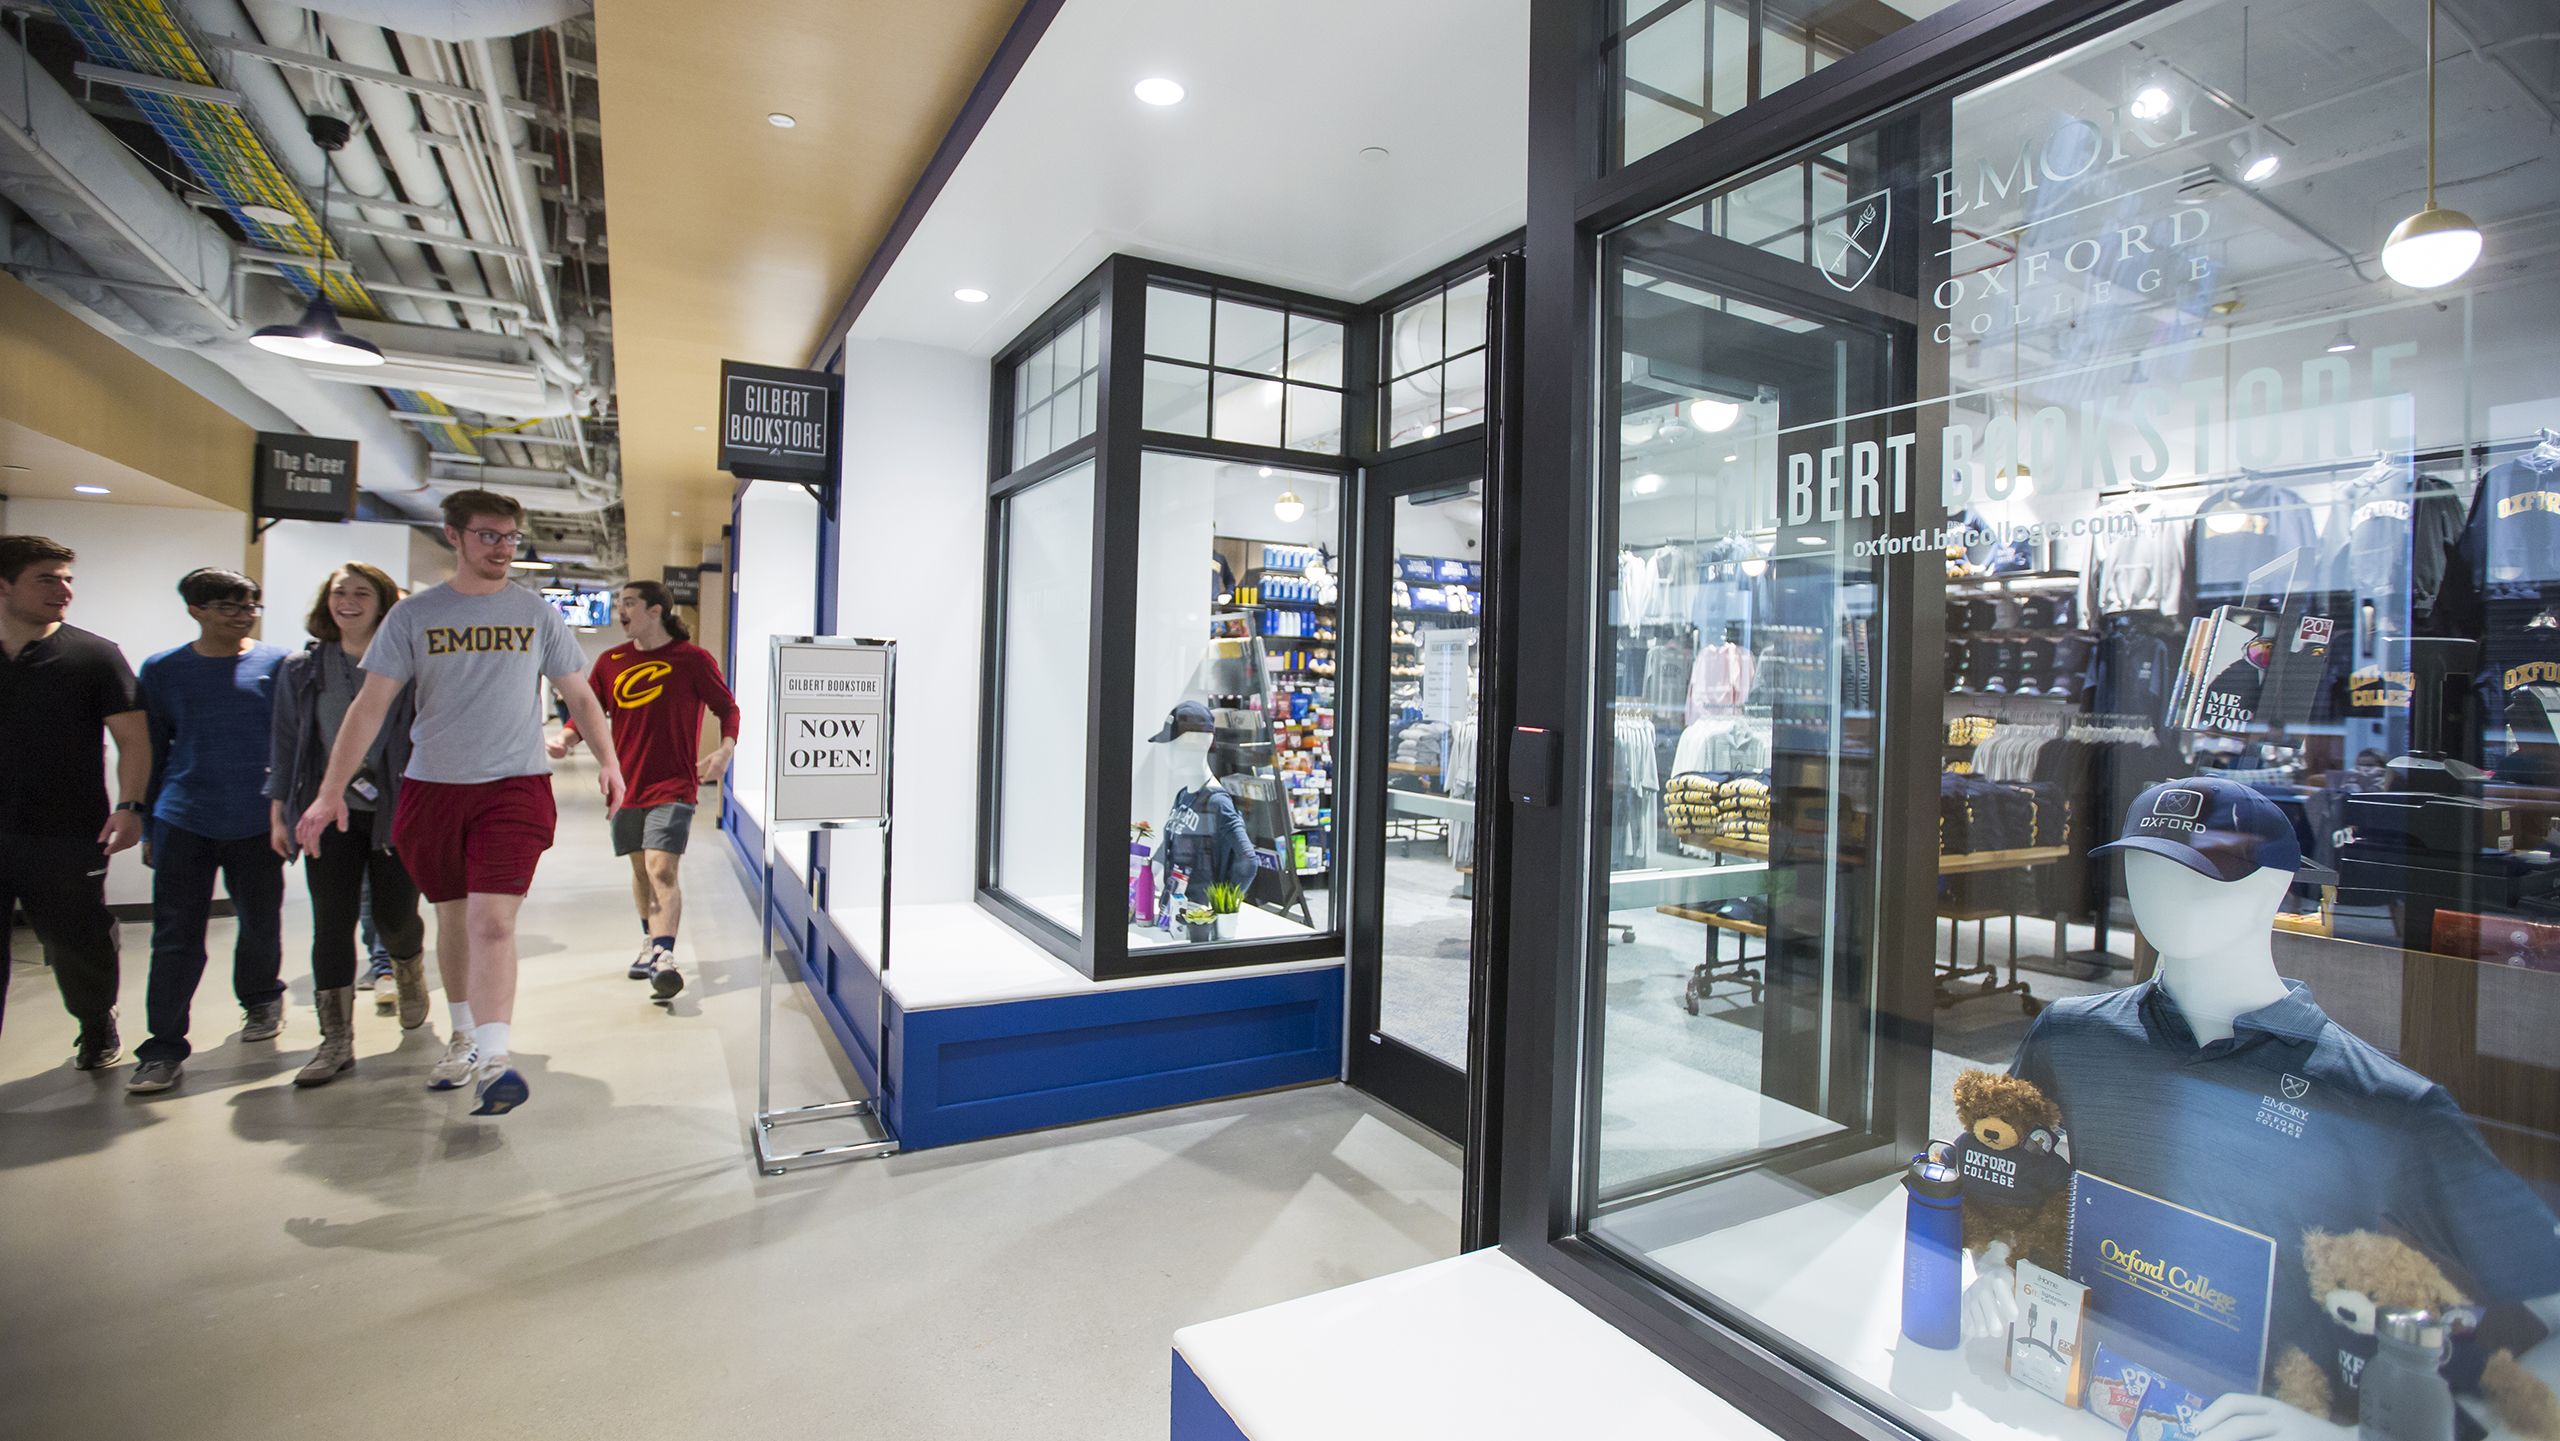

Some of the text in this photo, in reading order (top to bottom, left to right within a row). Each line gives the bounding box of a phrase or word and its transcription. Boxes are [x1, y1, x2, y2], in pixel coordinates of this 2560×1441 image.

[1932, 94, 2199, 224] EMORY
[1934, 207, 2210, 309] OXFORD
[1933, 255, 2211, 344] COLLEGE
[745, 384, 810, 417] GILBERT
[730, 413, 822, 449] BOOKSTORE
[1941, 341, 2418, 507] BOOKSTORE
[273, 449, 346, 475] The Greer
[286, 471, 332, 494] Forum
[2497, 491, 2560, 519] OXFOR
[426, 626, 535, 655] EMORY
[788, 679, 877, 692] GILBERT BOOKSTORE
[2504, 662, 2560, 691] OXFO
[2205, 703, 2254, 722] ELTO
[2208, 691, 2241, 708] ME
[800, 718, 866, 738] NOW
[2202, 714, 2249, 733] JOH
[790, 749, 871, 769] OPEN!
[2140, 816, 2207, 835] OXFORD
[2261, 1095, 2309, 1121] EMORY
[2255, 1117, 2301, 1139] COLLEGE
[2257, 1110, 2303, 1133] OXFORD
[1965, 1149, 2017, 1175] OXFORD
[1963, 1164, 2015, 1188] COLLEGE
[2100, 1239, 2238, 1315] Oxford College
